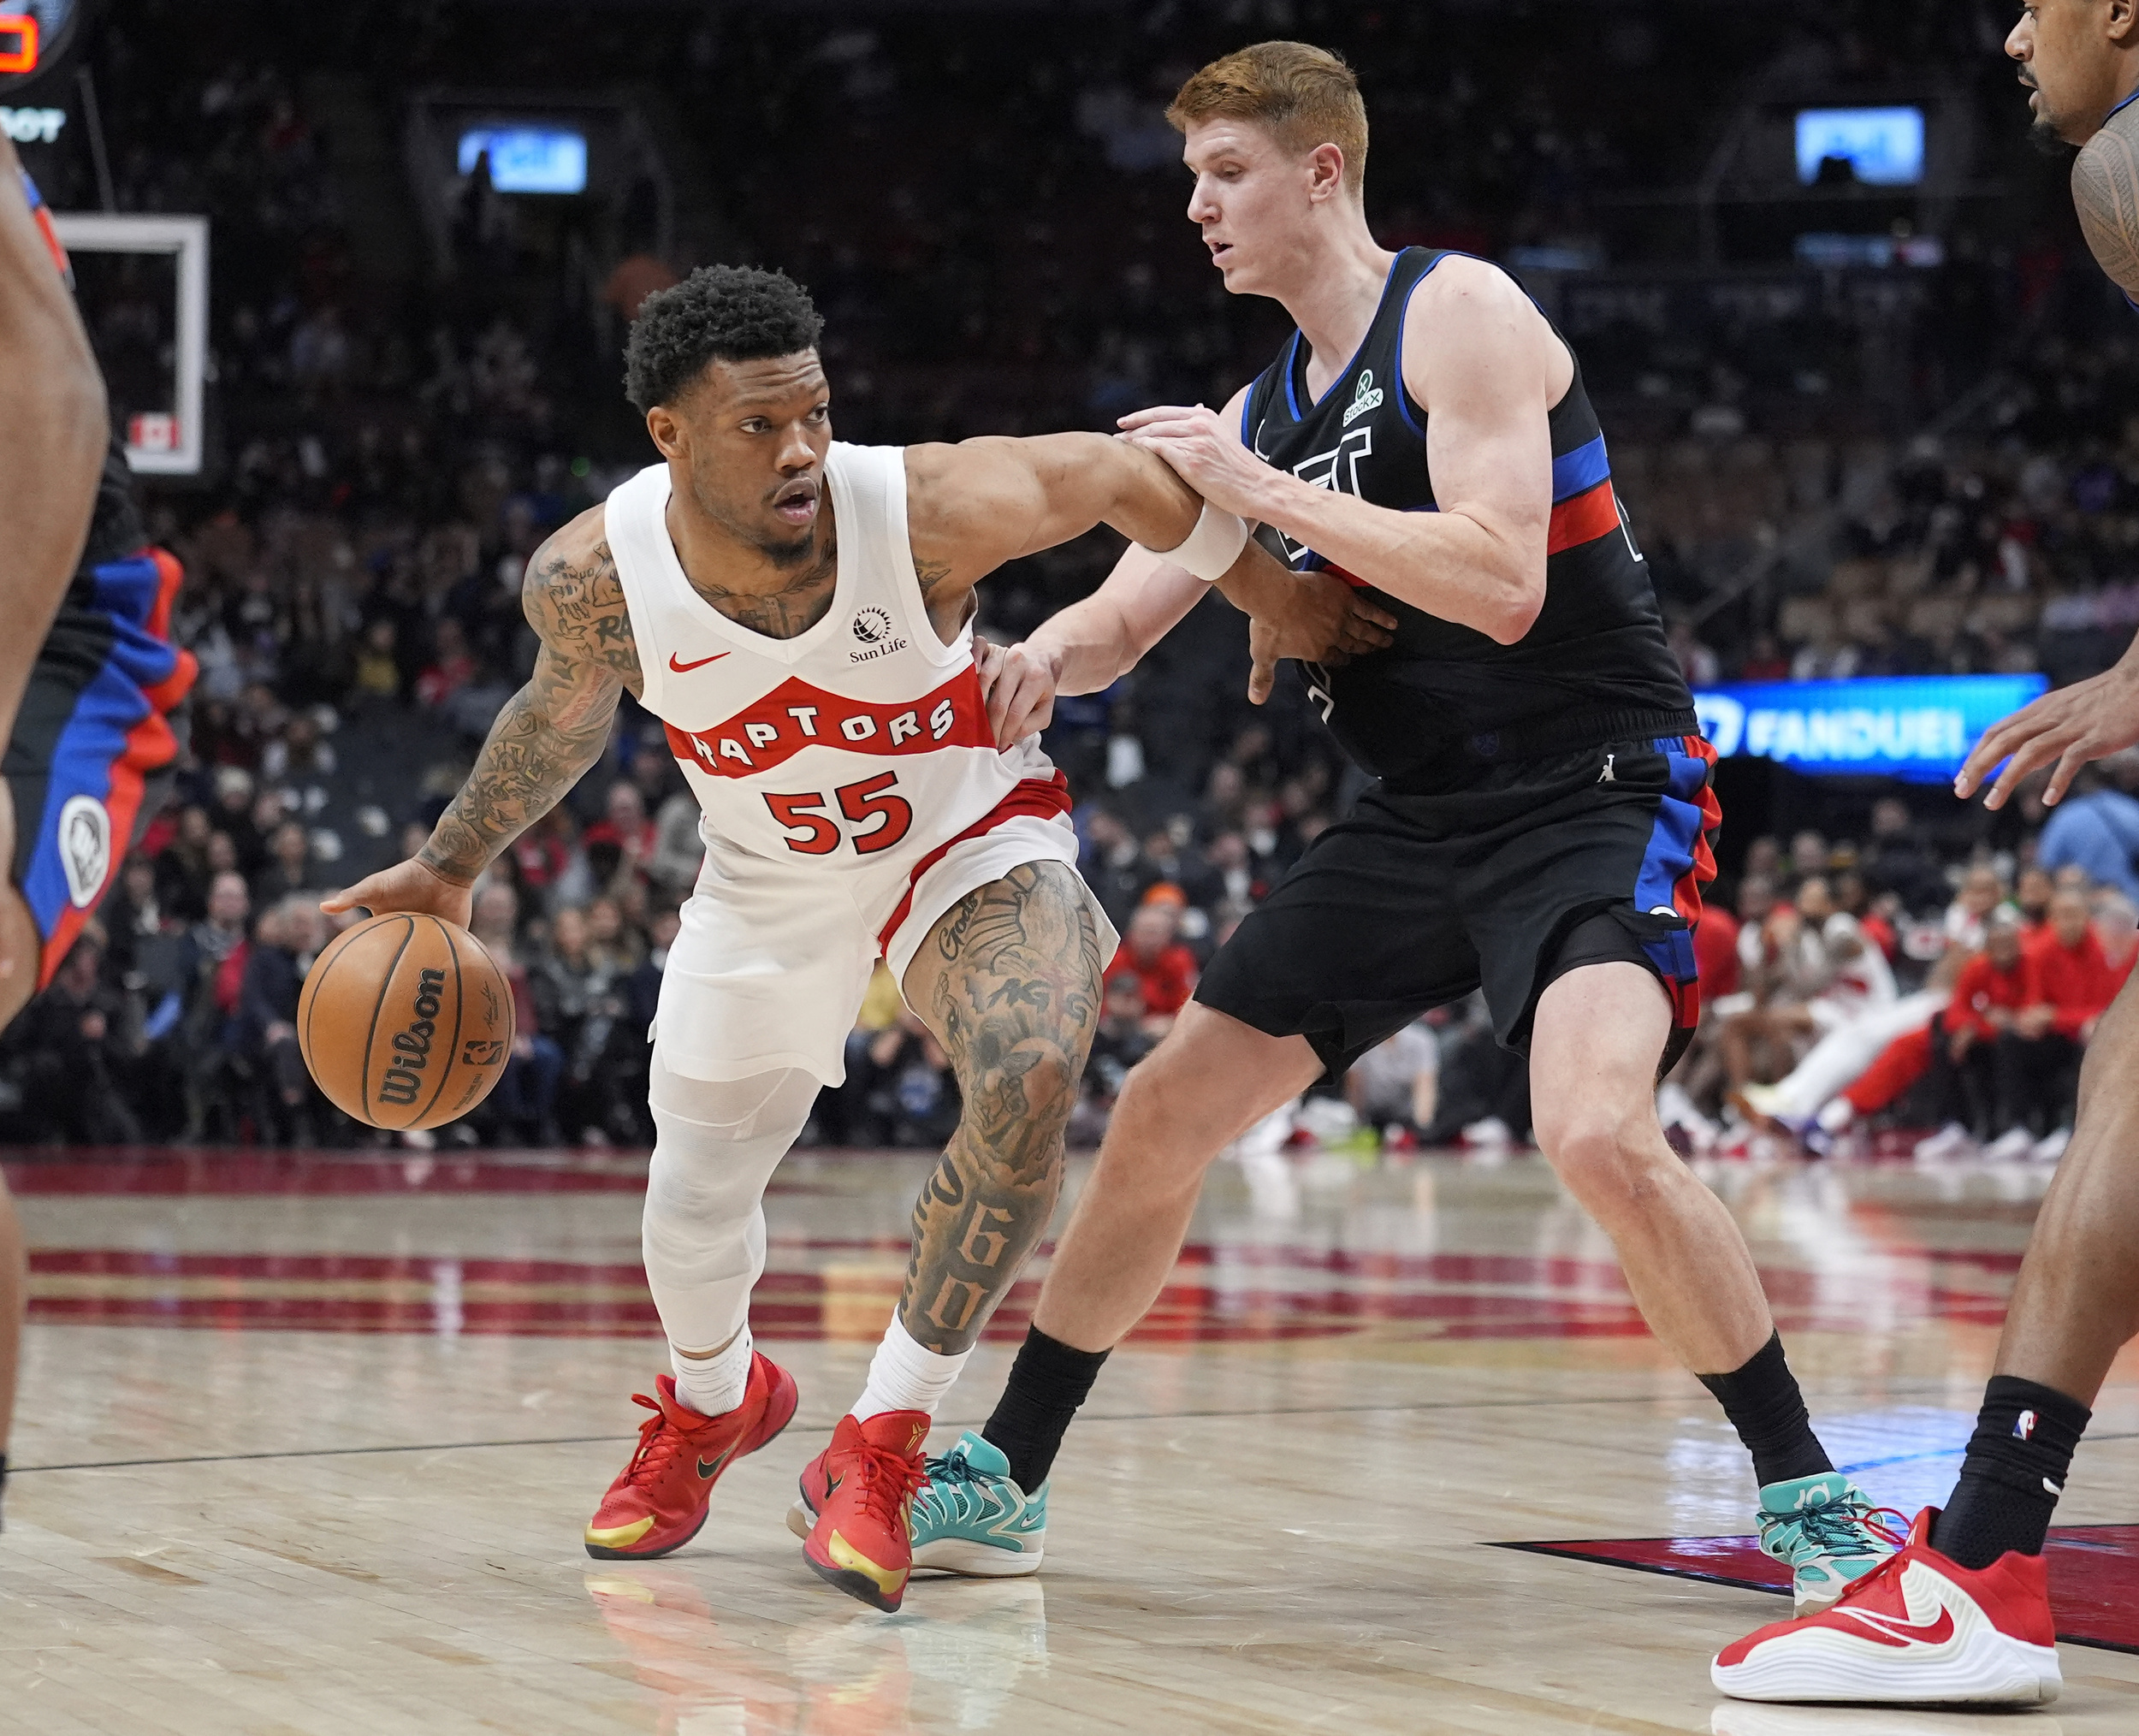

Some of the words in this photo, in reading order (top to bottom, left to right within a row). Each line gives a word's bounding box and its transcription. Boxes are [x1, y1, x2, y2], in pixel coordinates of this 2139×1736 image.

[850, 651, 879, 663] Sun
[880, 637, 908, 656] Life
[689, 698, 955, 770] RAPTORS
[762, 770, 913, 856] 55
[377, 967, 447, 1106] Wilson
